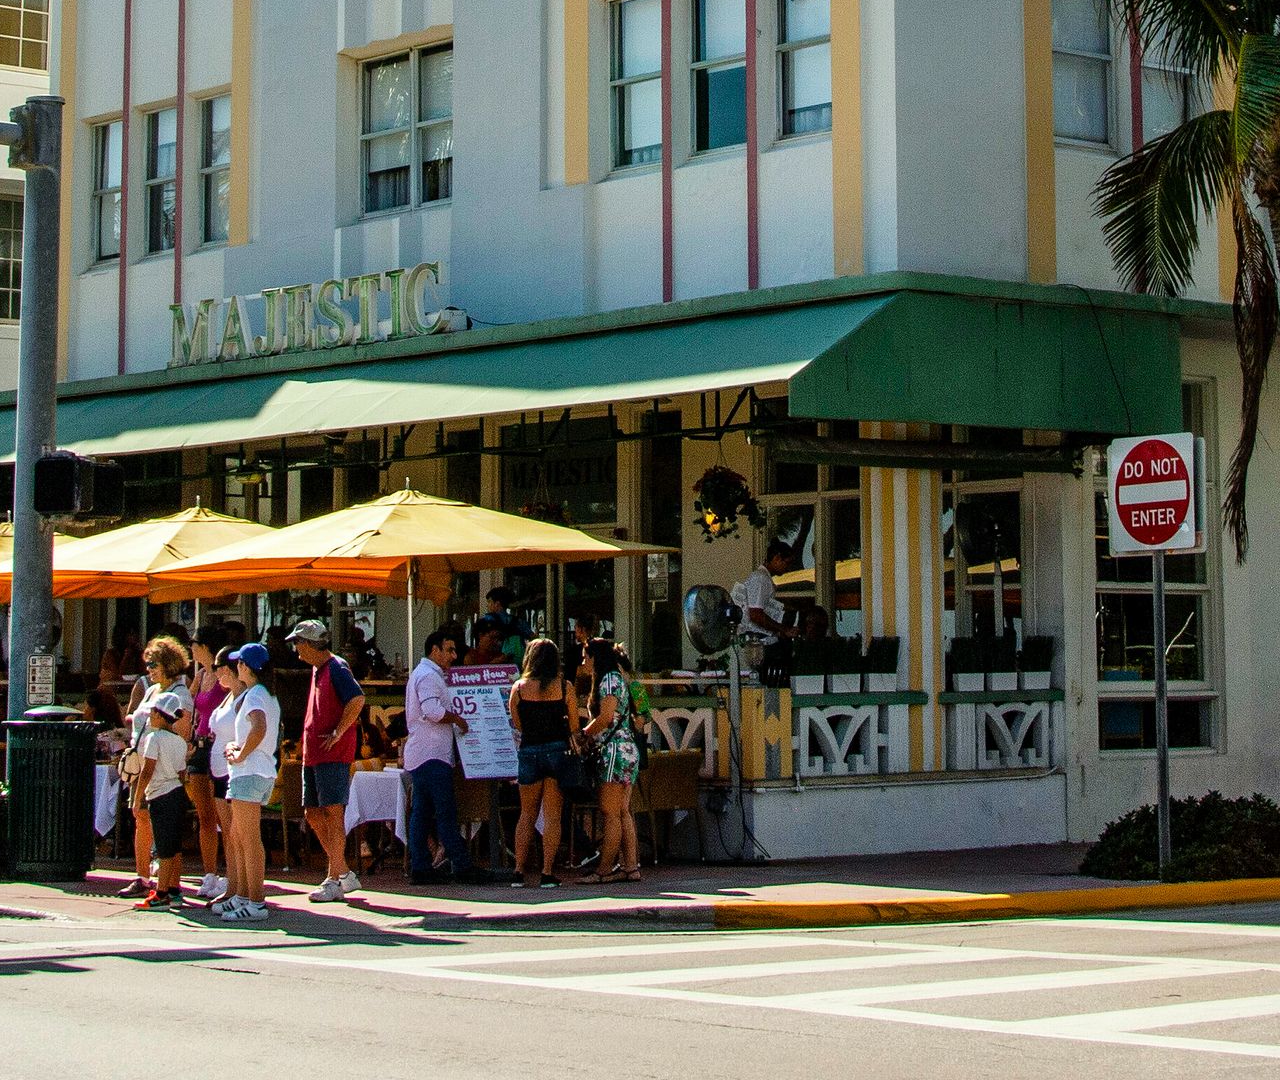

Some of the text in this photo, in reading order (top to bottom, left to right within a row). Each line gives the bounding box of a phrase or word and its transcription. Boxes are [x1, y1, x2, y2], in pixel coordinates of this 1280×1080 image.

[169, 260, 447, 367] MAJESTIC
[1124, 457, 1180, 479] DO NOT
[1131, 507, 1176, 528] ENTER
